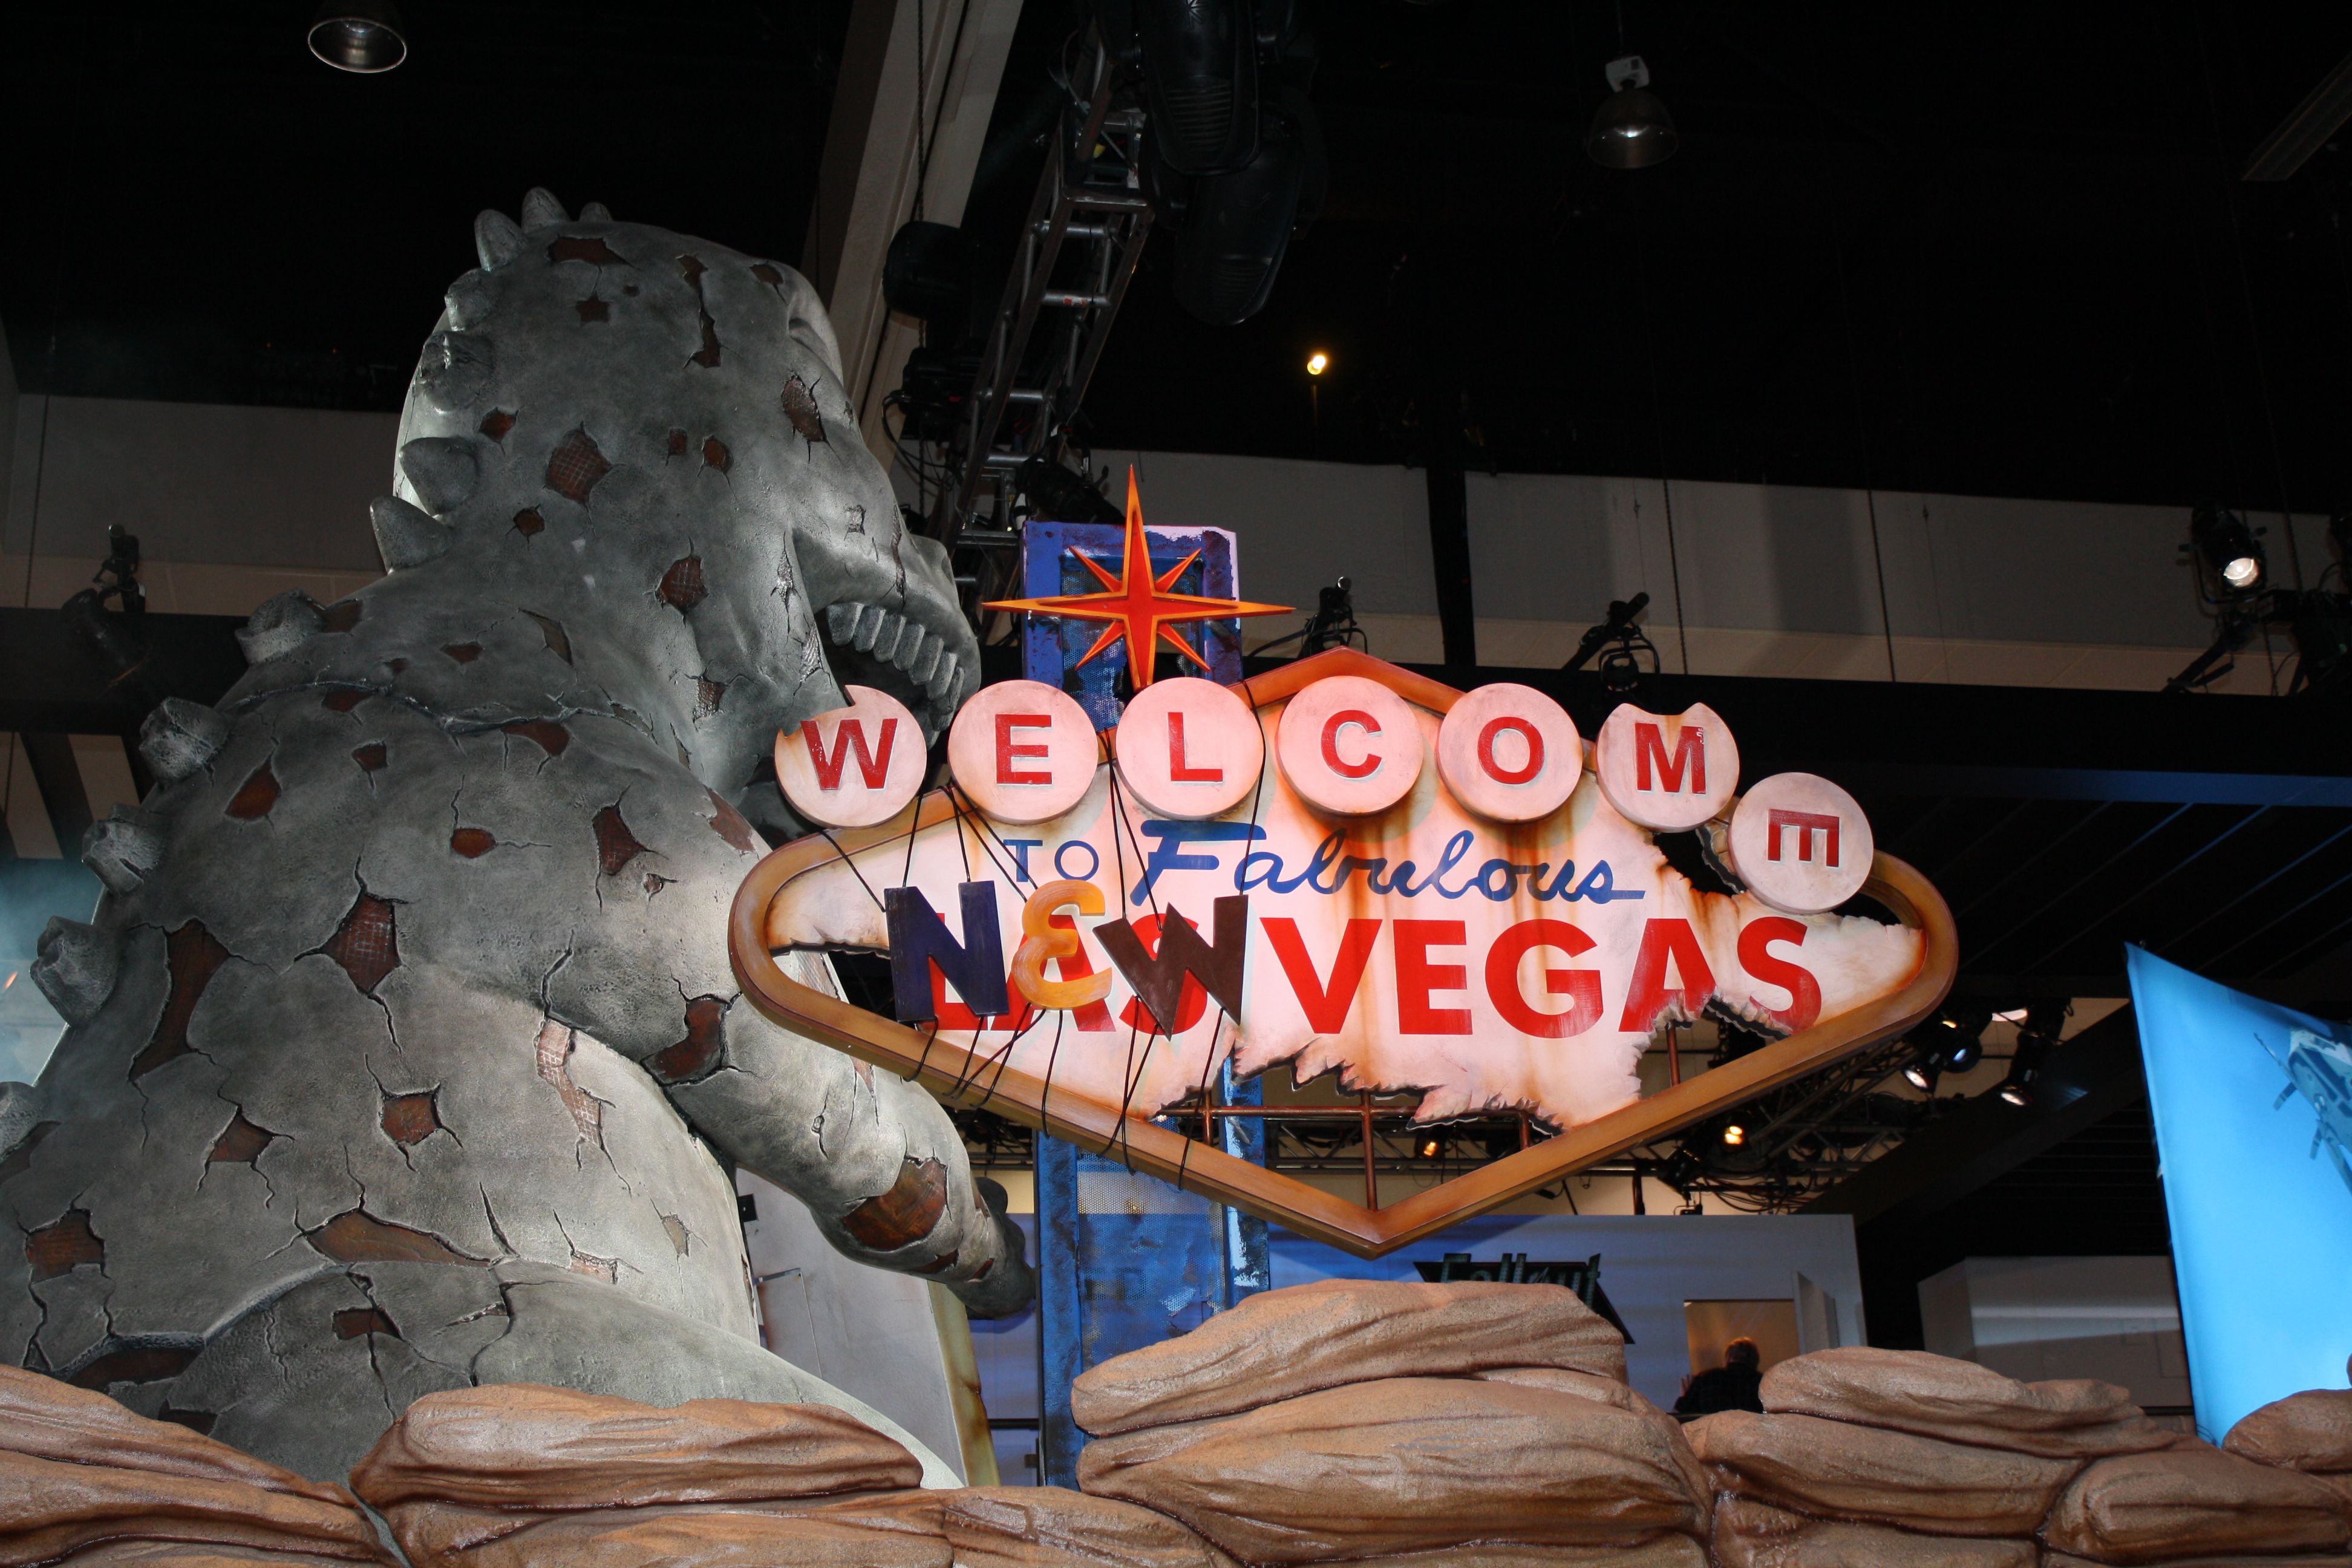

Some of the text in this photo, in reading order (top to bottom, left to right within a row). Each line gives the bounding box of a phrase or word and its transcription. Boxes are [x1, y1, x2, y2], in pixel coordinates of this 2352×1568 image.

[800, 709, 1840, 867] WELCOME
[1004, 819, 1645, 907] TO Fabulous
[884, 879, 1249, 1042] NEW
[1259, 916, 1822, 1039] VEGAS
